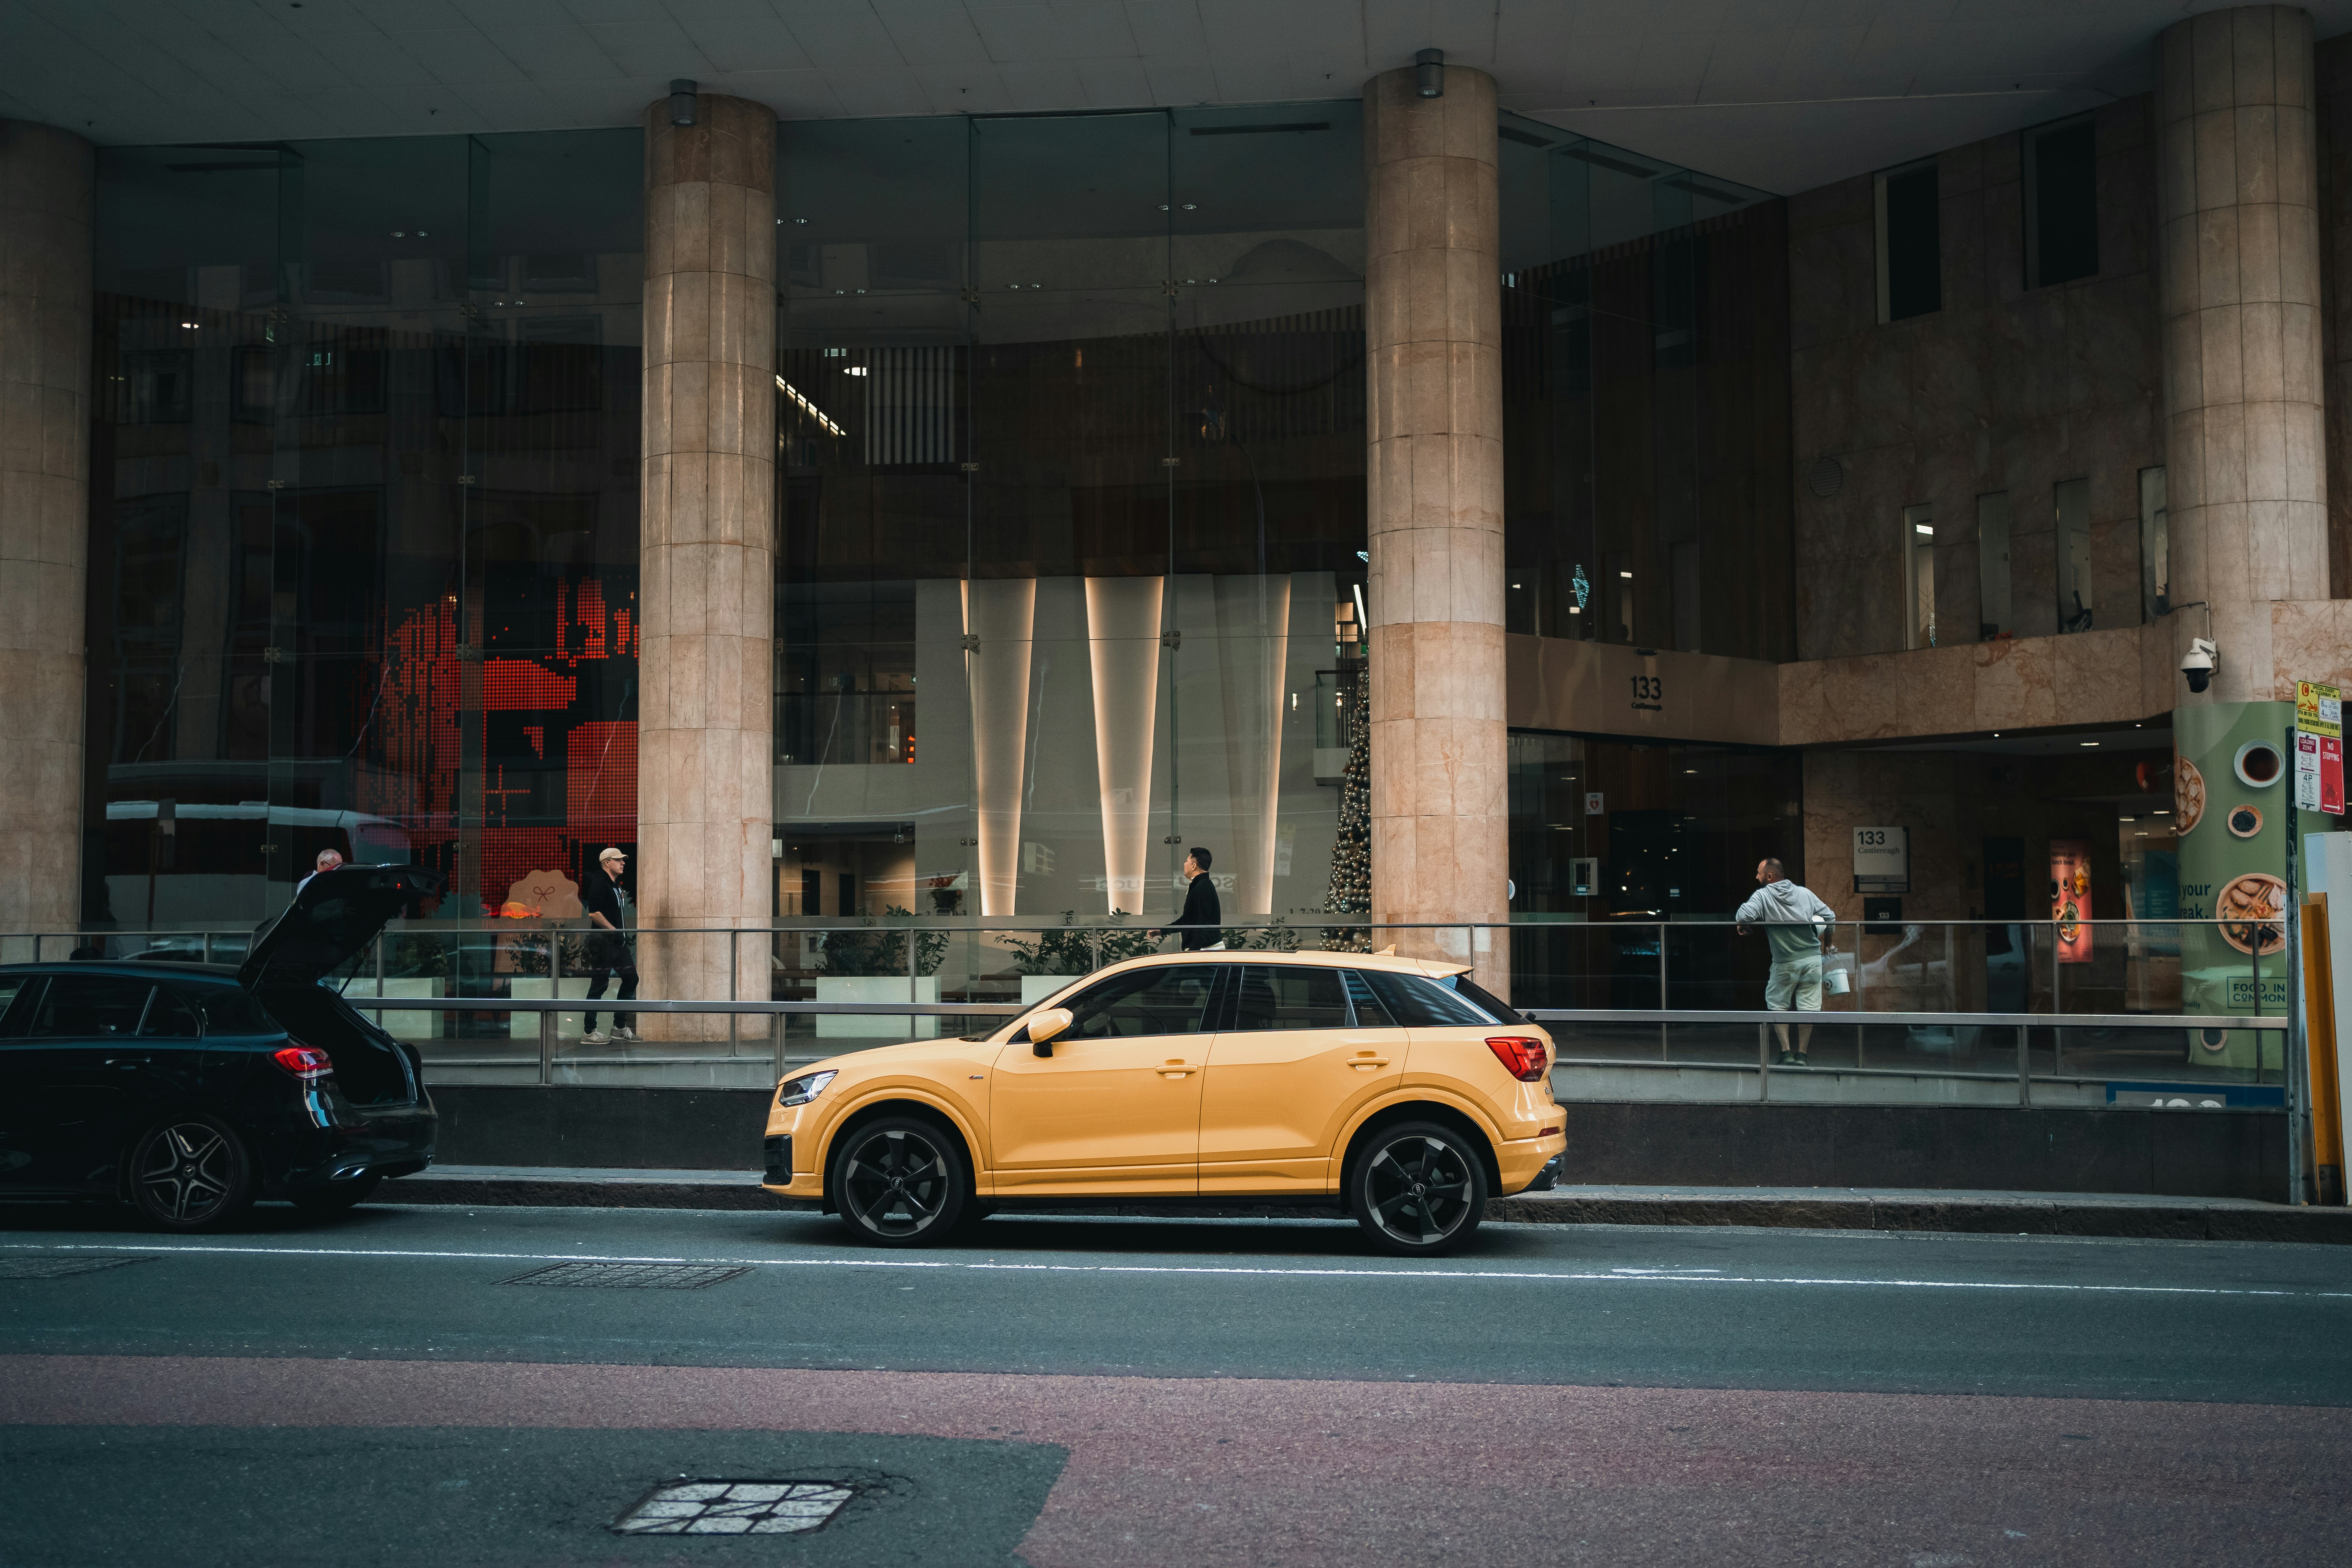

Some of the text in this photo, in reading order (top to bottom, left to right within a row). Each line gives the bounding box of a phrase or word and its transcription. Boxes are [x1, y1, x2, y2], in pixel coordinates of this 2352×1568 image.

[1630, 675, 1662, 700] 133
[1631, 702, 1662, 712] Castlereagh
[2327, 742, 2334, 750] NO
[2322, 751, 2339, 762] STOPPING
[1858, 831, 1885, 845] 133
[1858, 847, 1900, 855] Castlereagh
[2182, 884, 2211, 900] your
[2274, 984, 2285, 992] IN
